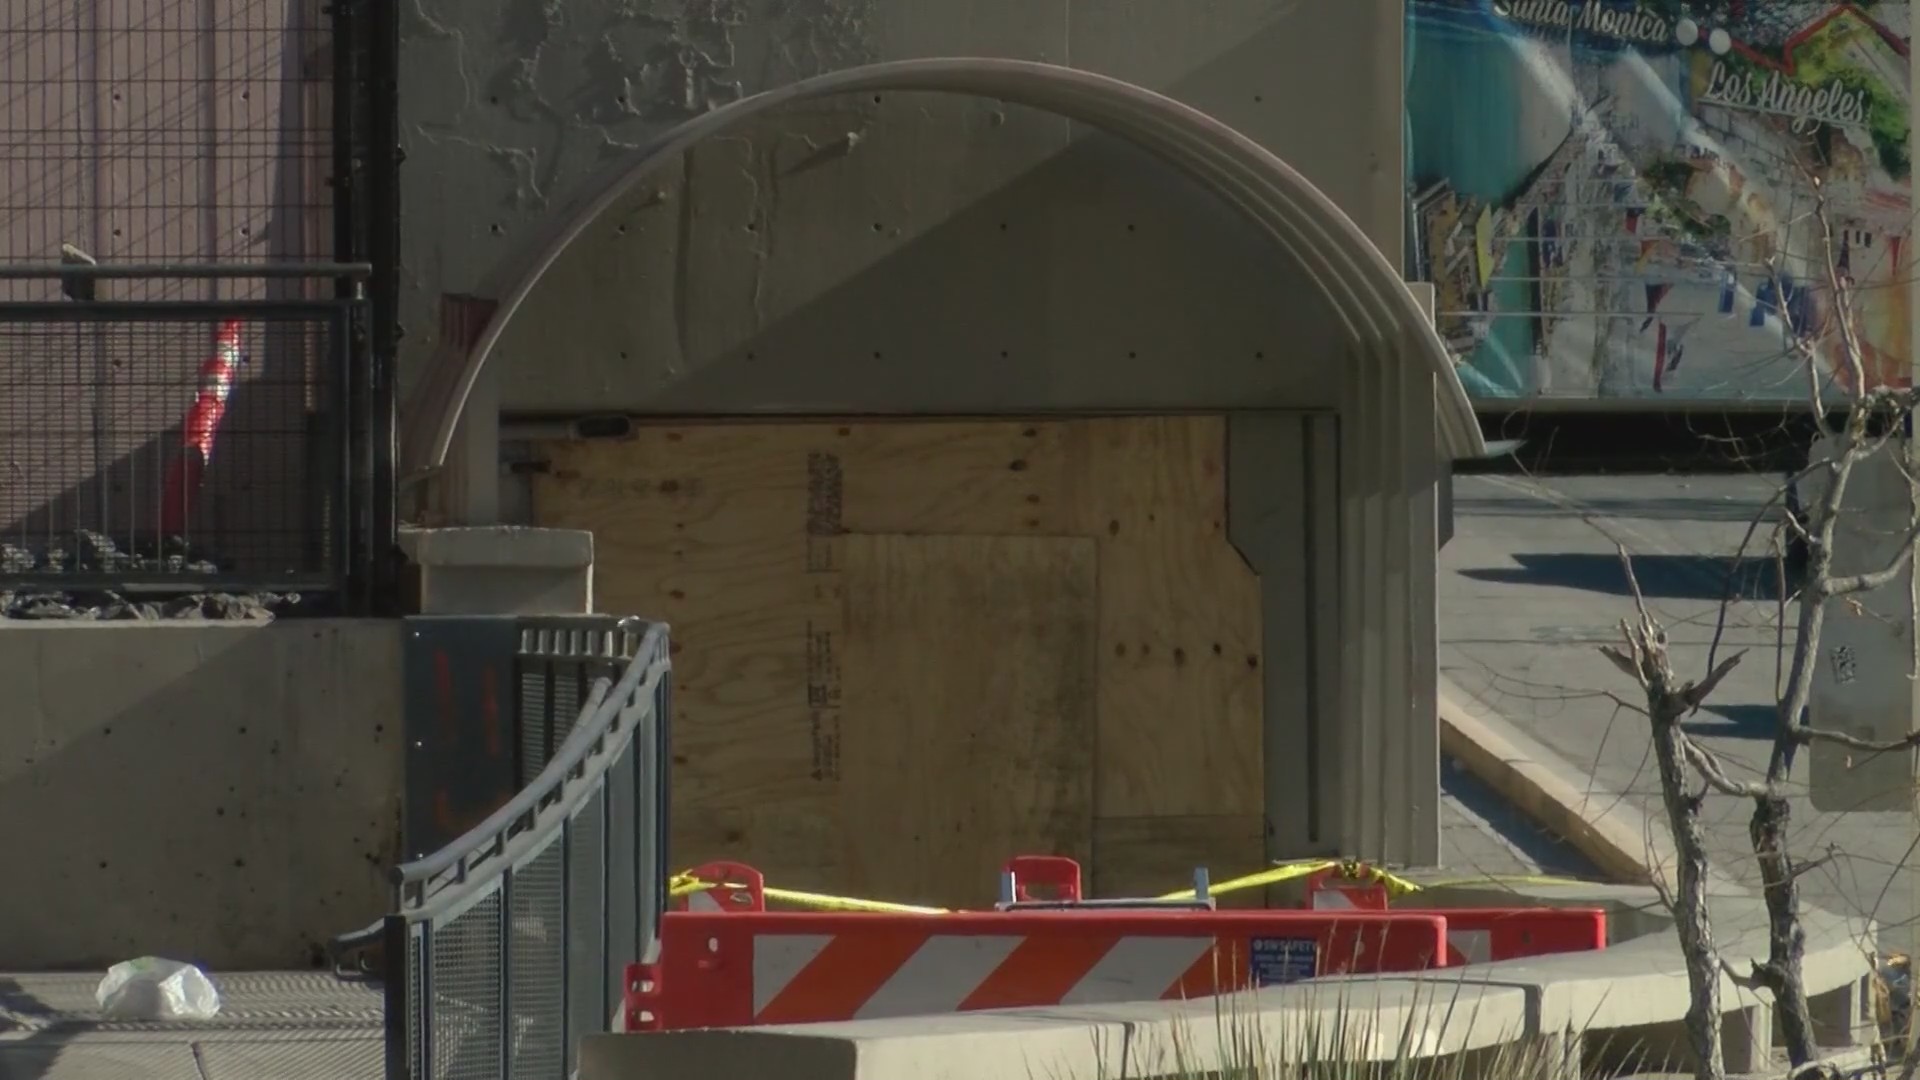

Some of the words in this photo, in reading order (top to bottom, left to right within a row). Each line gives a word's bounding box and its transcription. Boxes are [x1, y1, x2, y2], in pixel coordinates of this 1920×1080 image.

[1576, 0, 1668, 42] Monica
[1705, 61, 1752, 104] Los
[1756, 70, 1865, 135] Angeles
